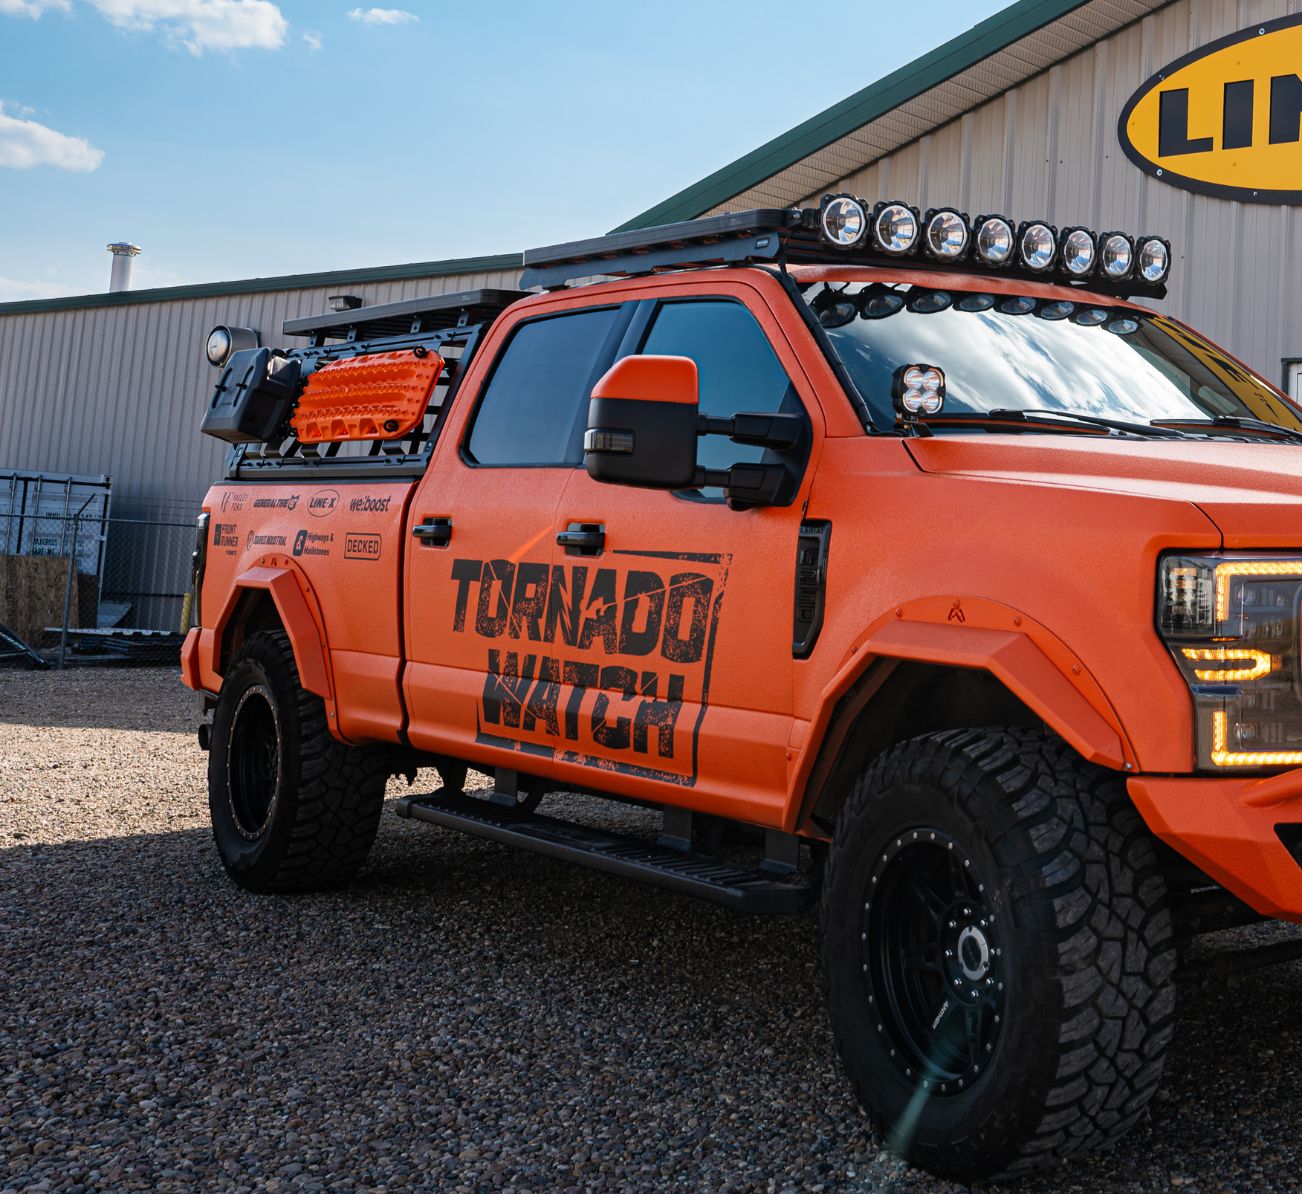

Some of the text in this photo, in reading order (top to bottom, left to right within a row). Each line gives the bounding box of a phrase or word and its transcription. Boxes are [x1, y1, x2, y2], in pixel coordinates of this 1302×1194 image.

[307, 532, 329, 544] Highways
[346, 539, 379, 554] DECKED
[451, 559, 714, 664] TORNADO
[482, 648, 685, 759] WATCH
